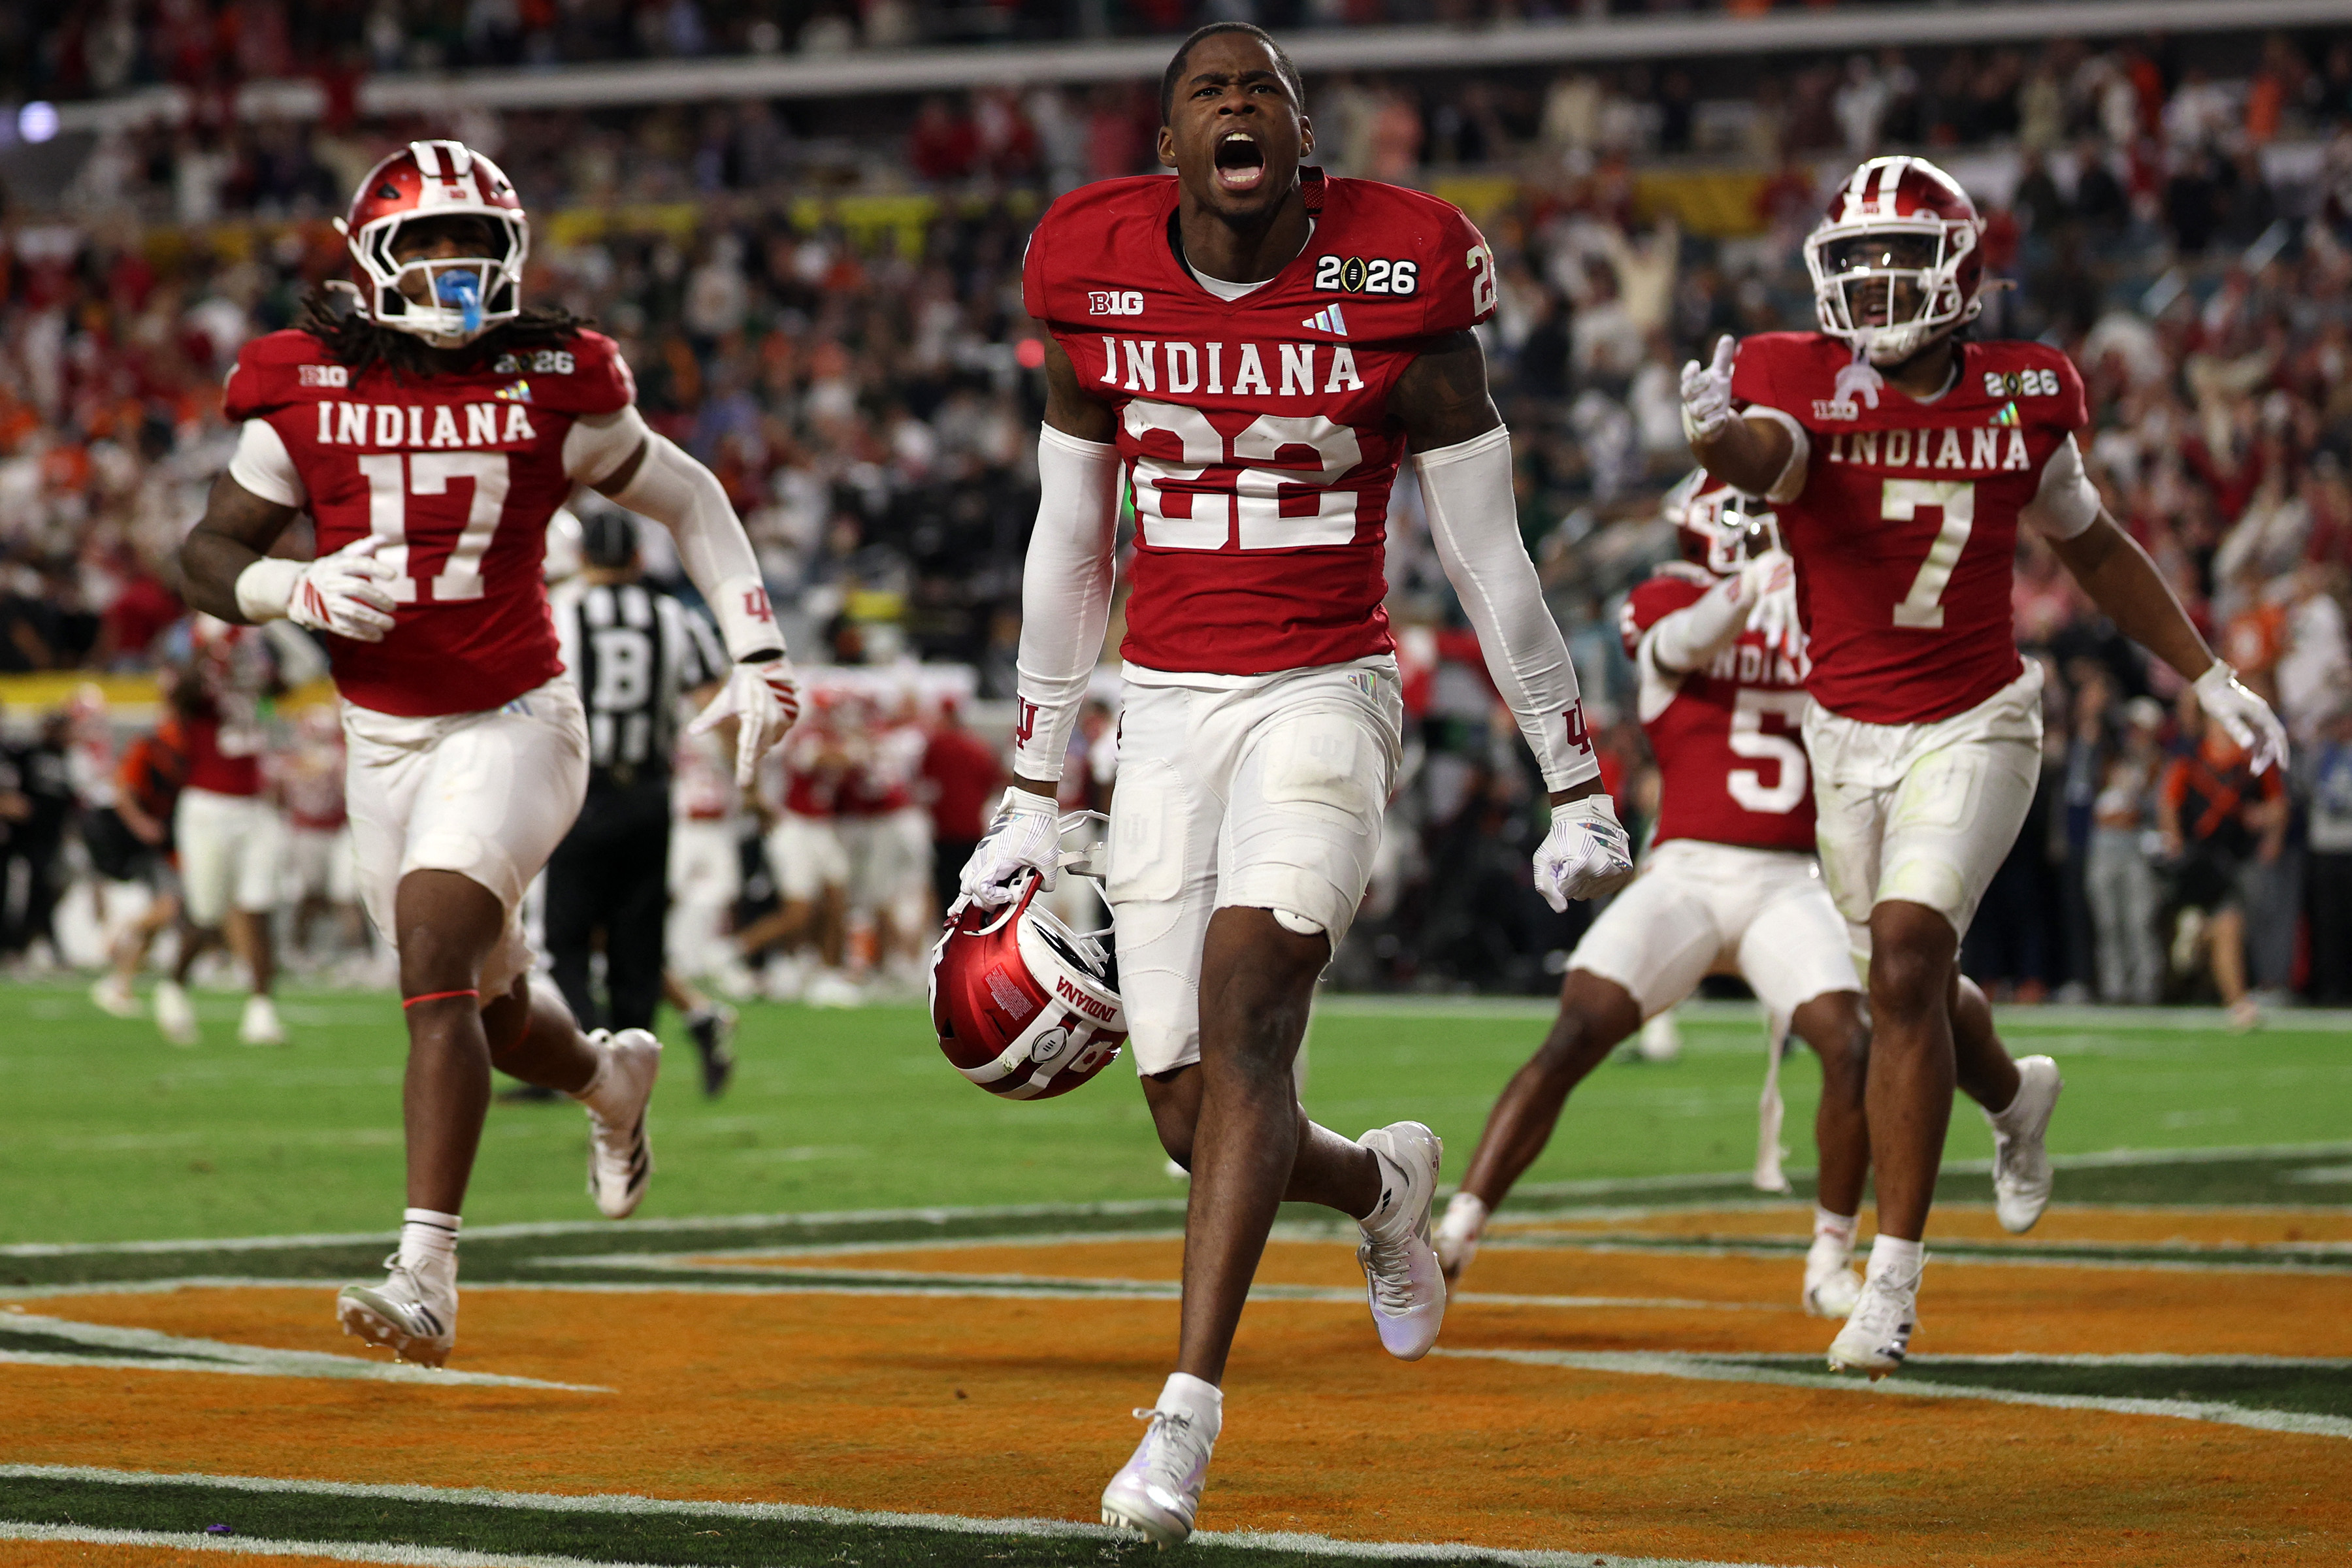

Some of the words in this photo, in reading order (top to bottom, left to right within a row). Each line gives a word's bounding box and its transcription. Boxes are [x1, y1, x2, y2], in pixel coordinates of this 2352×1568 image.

[1100, 336, 1364, 395] INDIANA
[318, 401, 536, 447] INDIANA
[1830, 427, 2030, 470] INDIANA
[1122, 396, 1362, 549] 22
[358, 451, 510, 602] 17
[1881, 478, 1975, 629] 7
[591, 625, 652, 712] B
[1727, 688, 1810, 815] 5
[1056, 975, 1117, 1023] INDIANA
